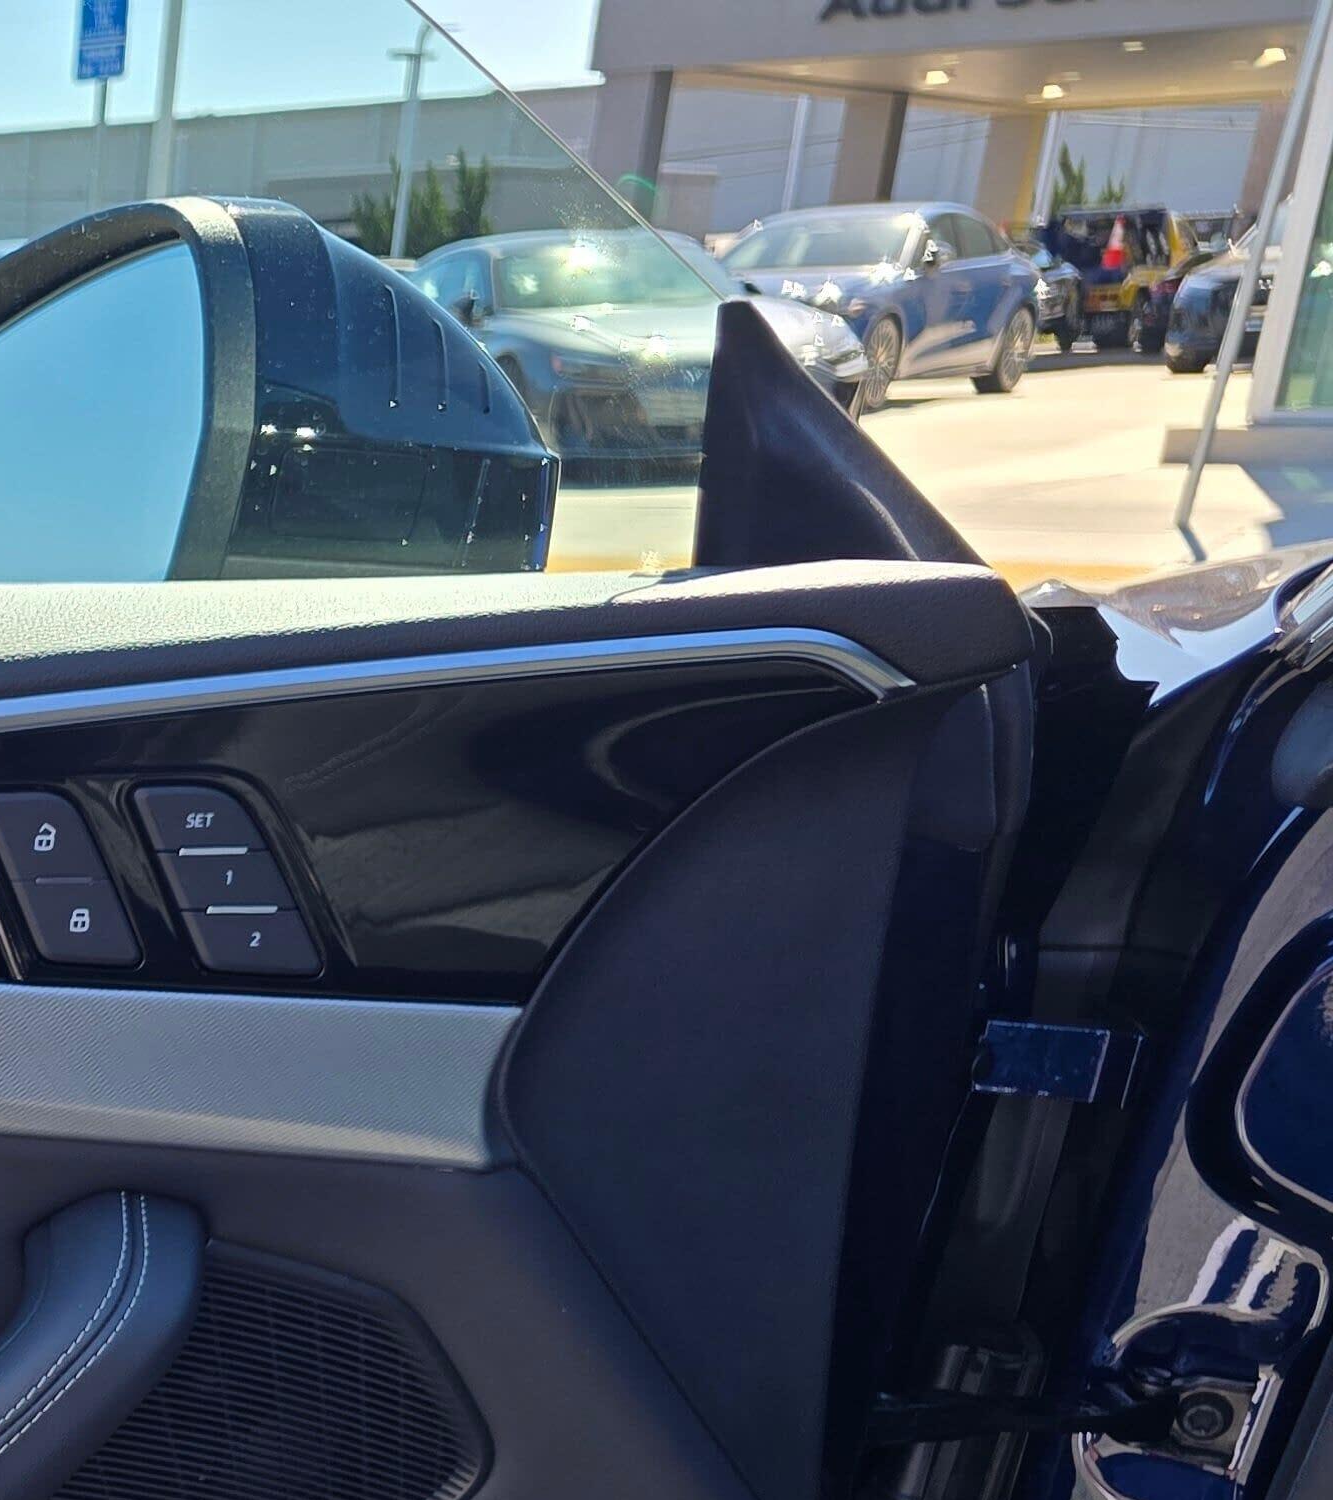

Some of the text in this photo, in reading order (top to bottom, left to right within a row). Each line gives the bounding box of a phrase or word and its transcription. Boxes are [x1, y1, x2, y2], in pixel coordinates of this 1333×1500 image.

[185, 812, 215, 829] SET
[225, 869, 233, 886] 1
[249, 931, 261, 948] 2
